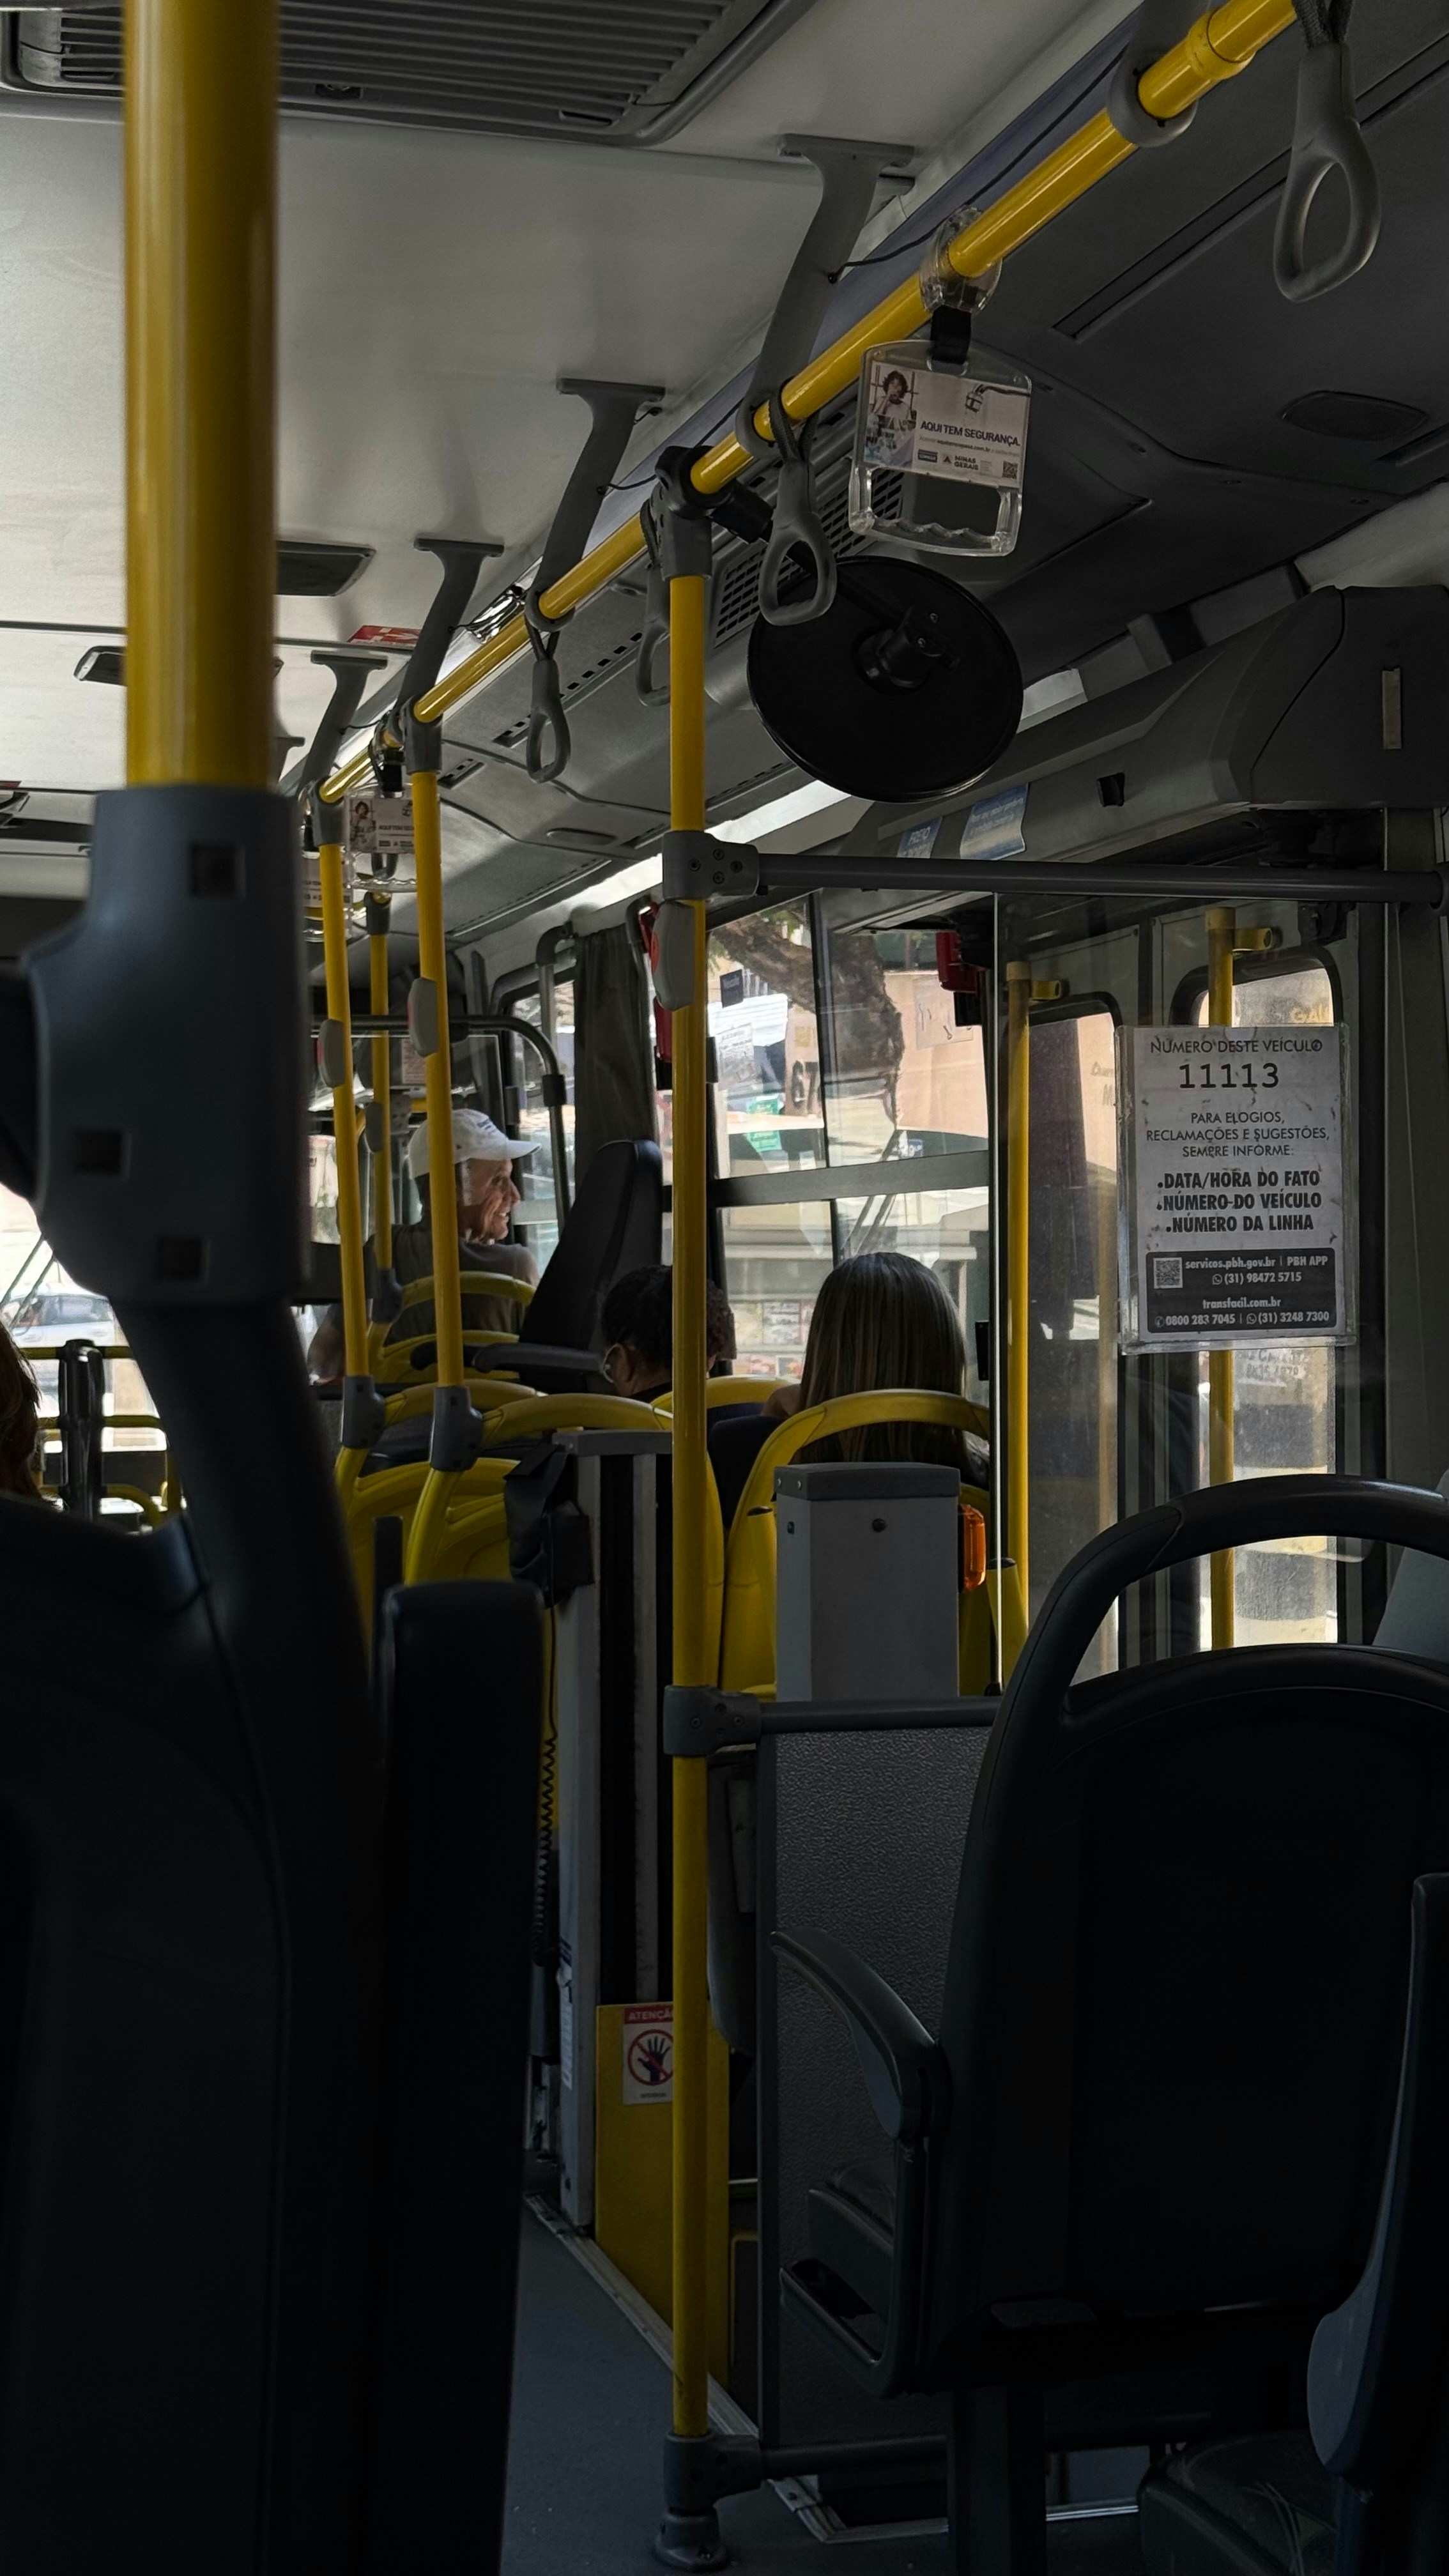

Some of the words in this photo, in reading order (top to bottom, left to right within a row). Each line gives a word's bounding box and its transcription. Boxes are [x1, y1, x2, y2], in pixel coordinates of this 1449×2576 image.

[920, 420, 942, 433] AQUI
[943, 424, 963, 436] TEM
[964, 428, 1020, 447] SEGURANÇA.
[954, 455, 976, 464] MINAS
[954, 461, 979, 471] GERAIS
[1218, 1040, 1259, 1052] DESTE
[1262, 1036, 1322, 1052] VEÍCULO
[1179, 1062, 1279, 1089] 11113
[1191, 1112, 1222, 1124] PARA
[1225, 1111, 1285, 1124] ELOGIOS,
[1146, 1126, 1238, 1143] RECLAMAÇÕES
[1243, 1128, 1250, 1140] E
[1253, 1124, 1330, 1141] SUGESTÕES,
[1183, 1146, 1229, 1158] SEMPRE
[1257, 1171, 1278, 1186] DO
[1284, 1170, 1320, 1186] FATO
[1234, 1193, 1255, 1209] DO
[1260, 1188, 1322, 1209] VEÍCULO
[1243, 1216, 1264, 1232] DA
[1269, 1215, 1314, 1230] LINHA
[1287, 1255, 1307, 1267] PBH
[1309, 1255, 1328, 1266] APP
[1224, 1272, 1244, 1285] (31)
[1246, 1271, 1276, 1284] 98472
[1278, 1271, 1302, 1283] 5715
[1165, 1315, 1190, 1326] 0800
[1211, 1314, 1236, 1325] 7045
[1258, 1312, 1278, 1324] (31)
[1280, 1311, 1304, 1323] 3248
[1306, 1310, 1330, 1322] 7300
[628, 2007, 672, 2021] ATENÇÃ
